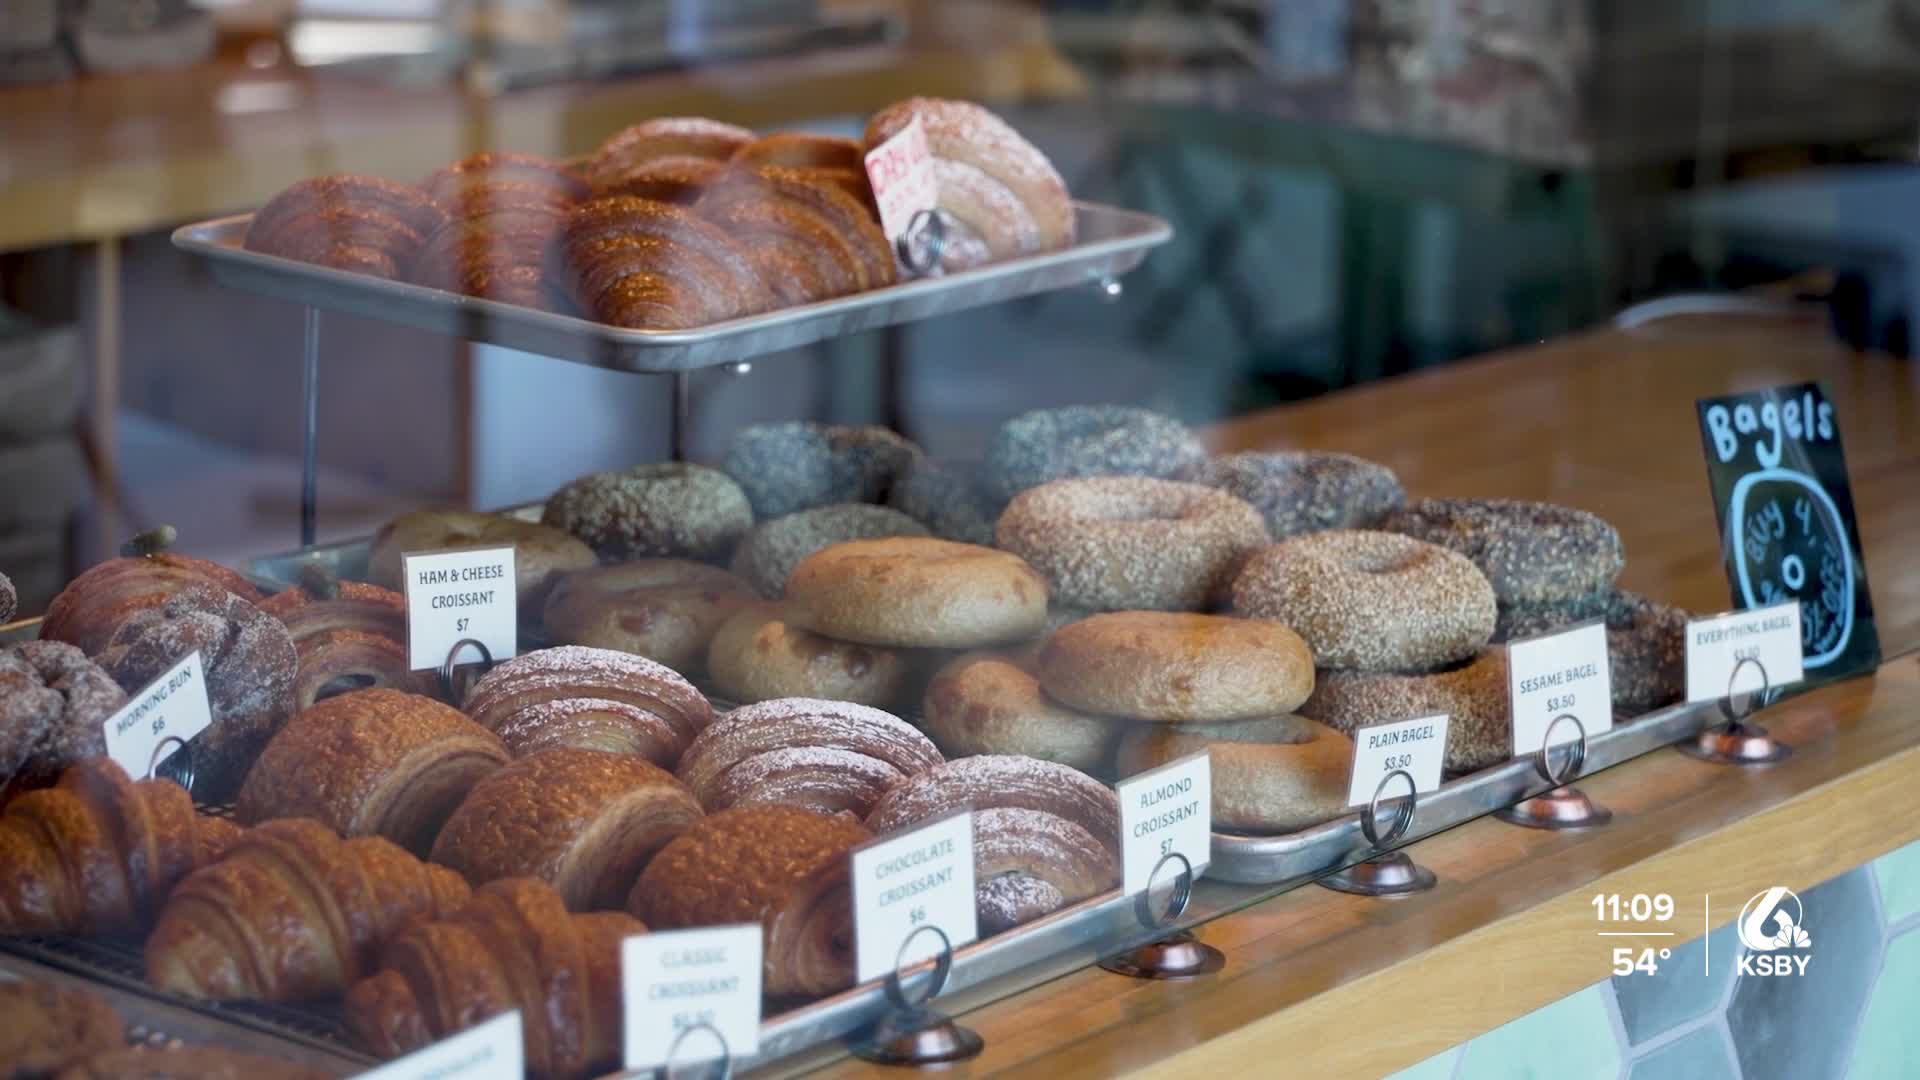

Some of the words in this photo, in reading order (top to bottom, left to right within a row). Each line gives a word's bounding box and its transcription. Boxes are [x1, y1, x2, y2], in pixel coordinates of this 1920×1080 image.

[1706, 392, 1834, 470] Bagels
[419, 570, 448, 585] HAM
[450, 569, 459, 583] &
[462, 565, 504, 581] CHEESE
[431, 590, 495, 609] CROISSANT
[456, 618, 469, 632] $7
[1696, 622, 1760, 646] EVERYTHING
[1762, 616, 1792, 632] BAGEL
[1520, 672, 1563, 694] SESAME
[1566, 664, 1598, 683] BAGEL
[116, 686, 168, 736] MORNING
[168, 666, 192, 694] BUN
[1547, 694, 1576, 713] $3.50
[151, 716, 166, 735] $6
[1369, 731, 1400, 750] PLAIN
[1401, 726, 1434, 743] BAGEL
[1383, 754, 1412, 771] $3.50
[1140, 777, 1192, 809] ALMOND
[1133, 800, 1199, 838] CROISSANT
[875, 838, 954, 880] CHOCOLATE
[1160, 837, 1173, 855] $7
[879, 866, 953, 908] CROISSANT
